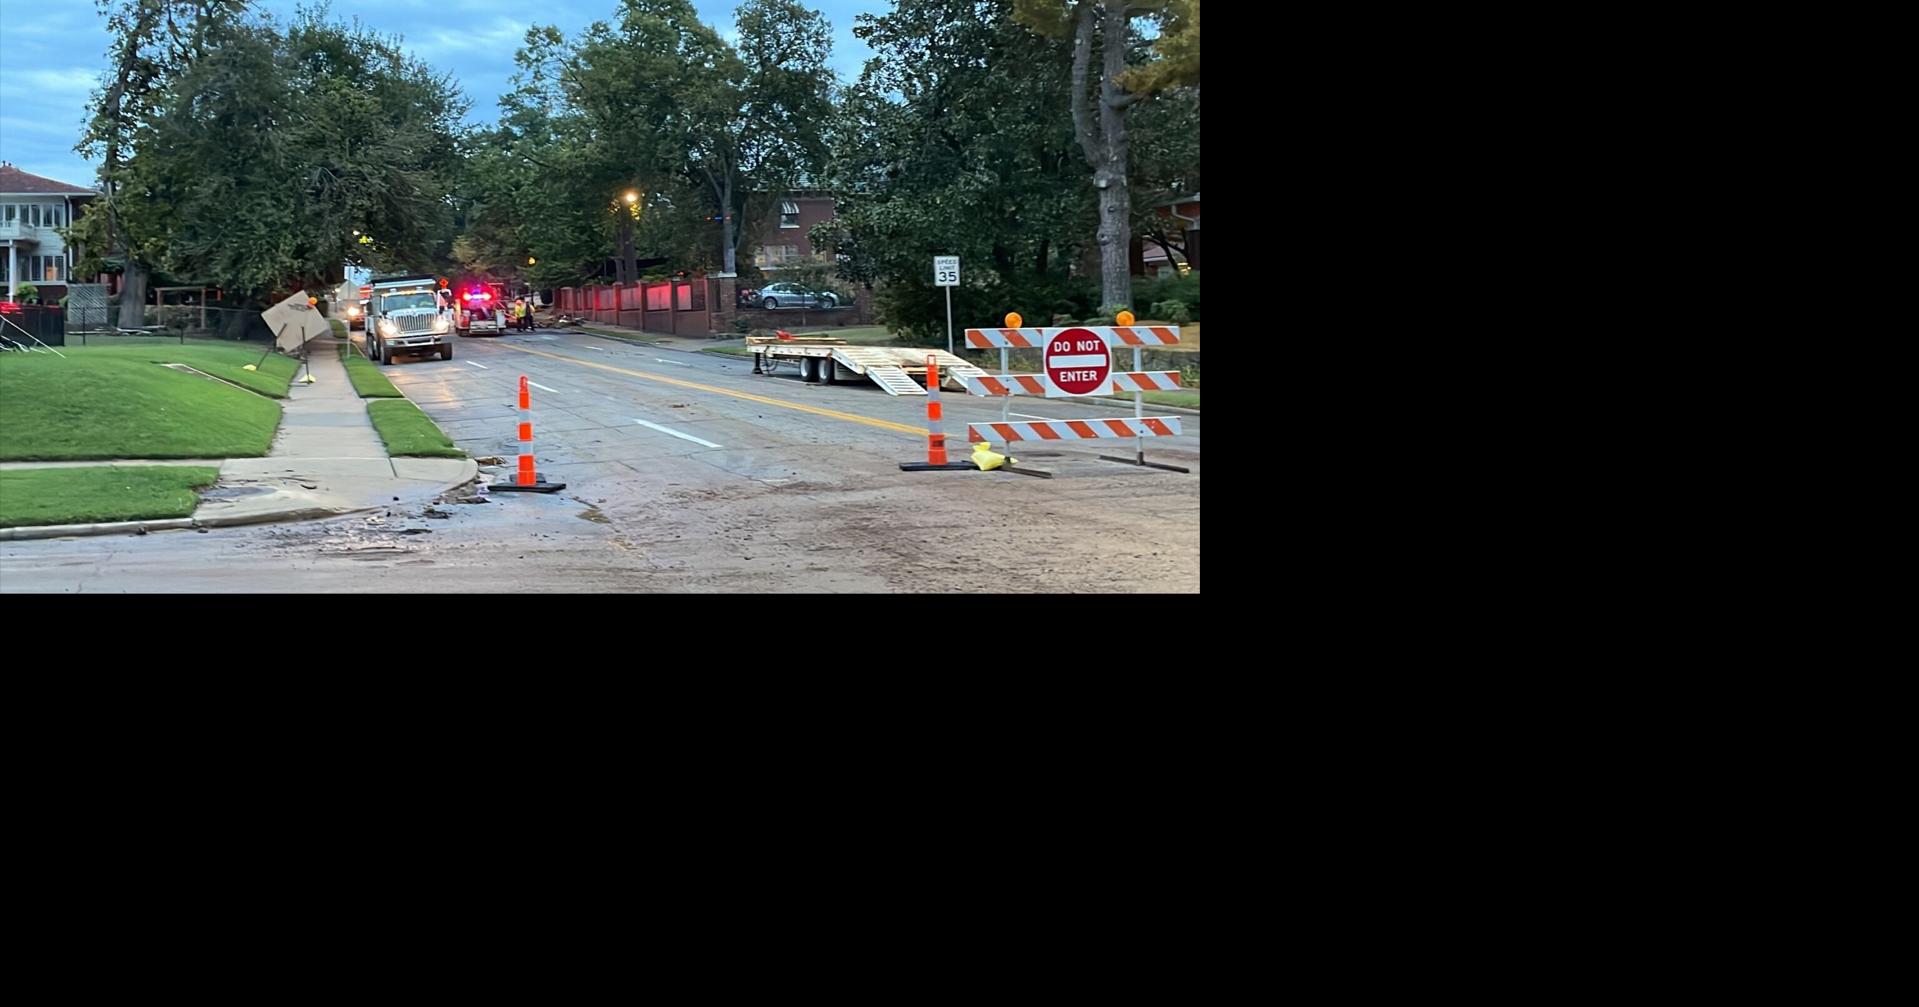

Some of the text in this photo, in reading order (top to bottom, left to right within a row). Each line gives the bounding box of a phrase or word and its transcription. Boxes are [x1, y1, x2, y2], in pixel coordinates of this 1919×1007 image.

[938, 271, 957, 282] 35
[1054, 340, 1100, 352] DO NOT
[1060, 370, 1098, 382] ENTER
